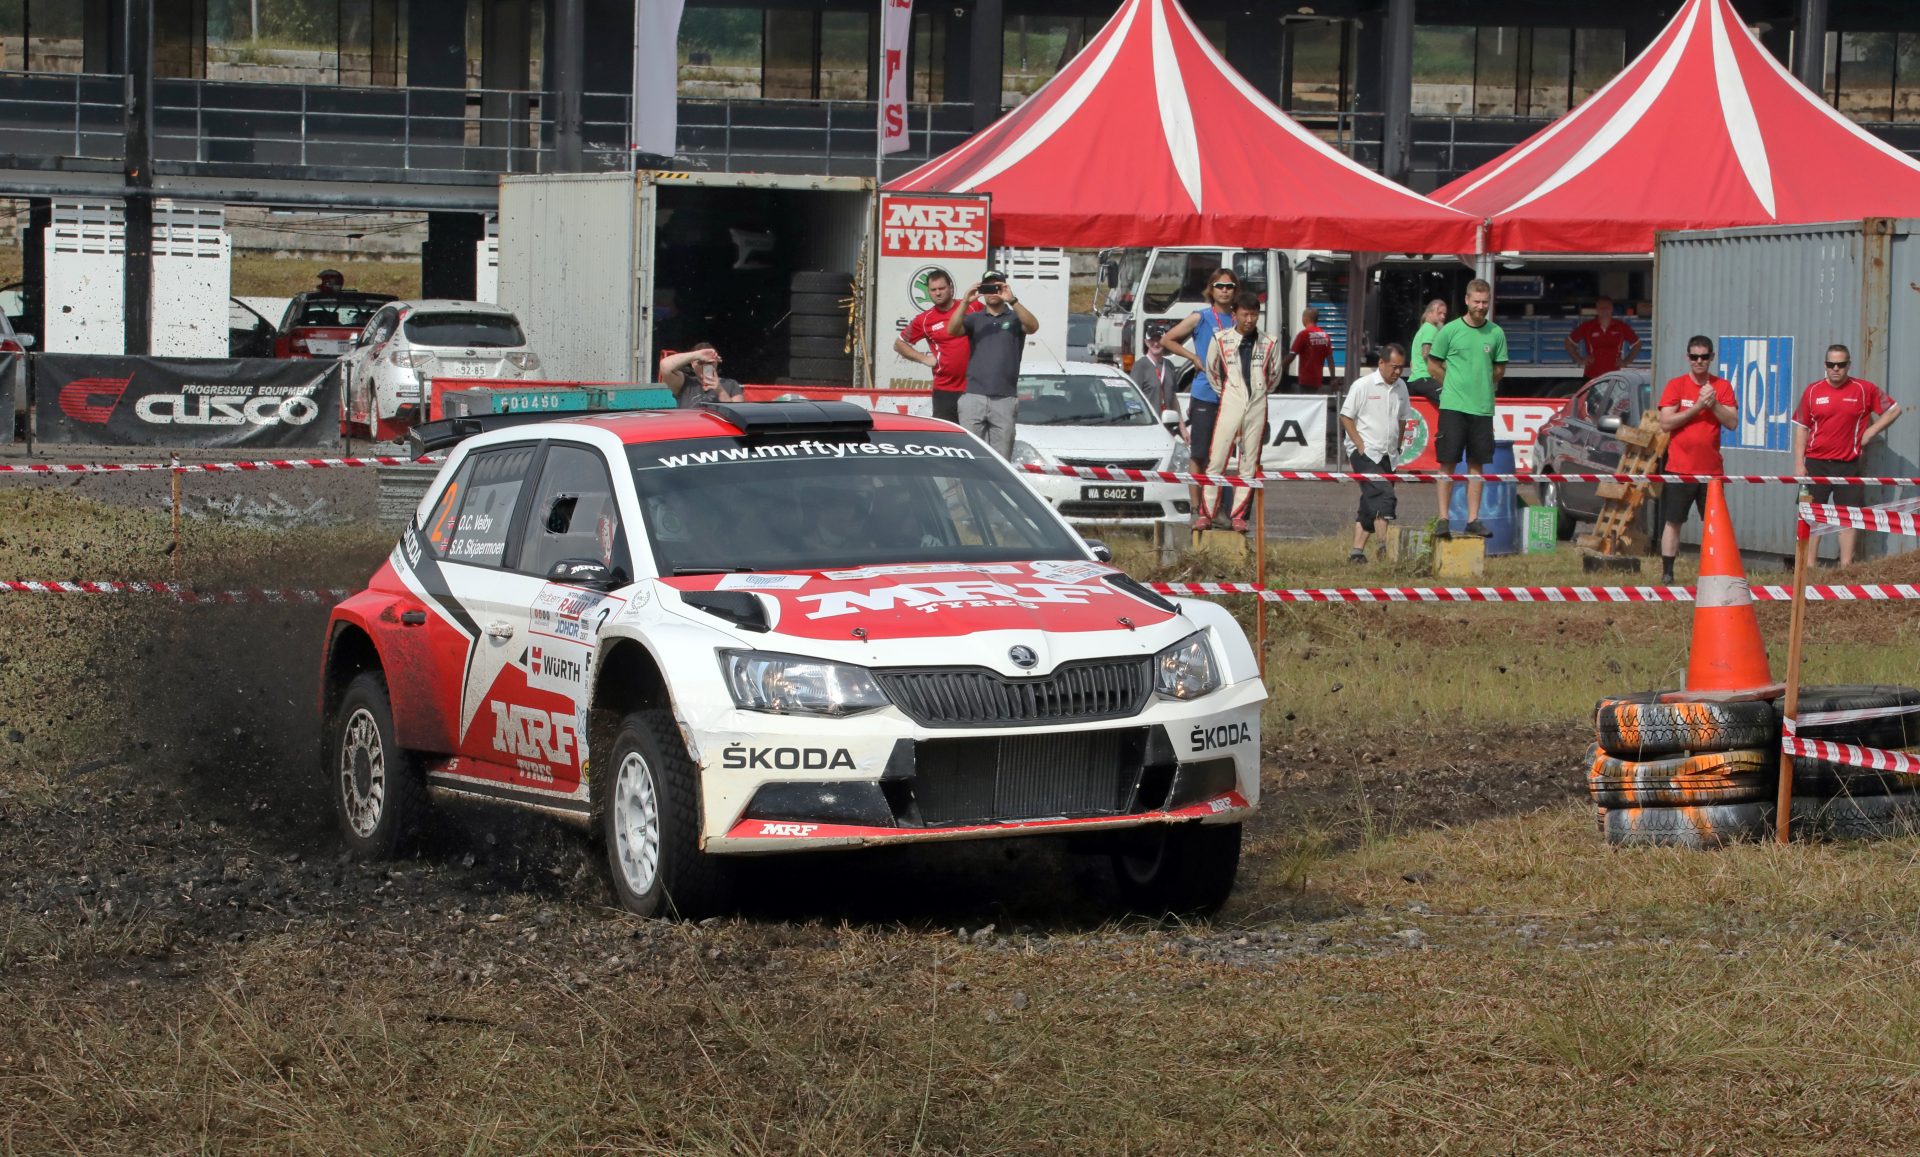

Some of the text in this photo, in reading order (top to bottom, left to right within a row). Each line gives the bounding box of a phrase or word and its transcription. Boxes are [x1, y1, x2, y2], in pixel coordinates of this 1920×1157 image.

[884, 204, 985, 229] MRF
[884, 228, 984, 253] TYRES
[181, 384, 317, 396] PROGRESSIVE EQUIPMENT
[135, 394, 319, 425] CUSCO
[658, 440, 976, 468] www.mrftyres.com
[1088, 488, 1137, 498] WA 6402 C
[431, 481, 458, 542] 2
[458, 514, 493, 534] O.C. Veiby
[449, 539, 505, 558] S.R. Skjaermoen
[571, 564, 605, 575] MRF
[796, 581, 1114, 620] MRF
[917, 600, 1040, 613] TYRES
[555, 620, 580, 637] JOHOR
[490, 699, 577, 766] MRF
[1190, 722, 1251, 752] ŠKODA
[723, 742, 857, 770] ŠKODA
[516, 758, 554, 784] TYRES
[1208, 797, 1232, 812] MRF
[759, 823, 818, 837] MRF
